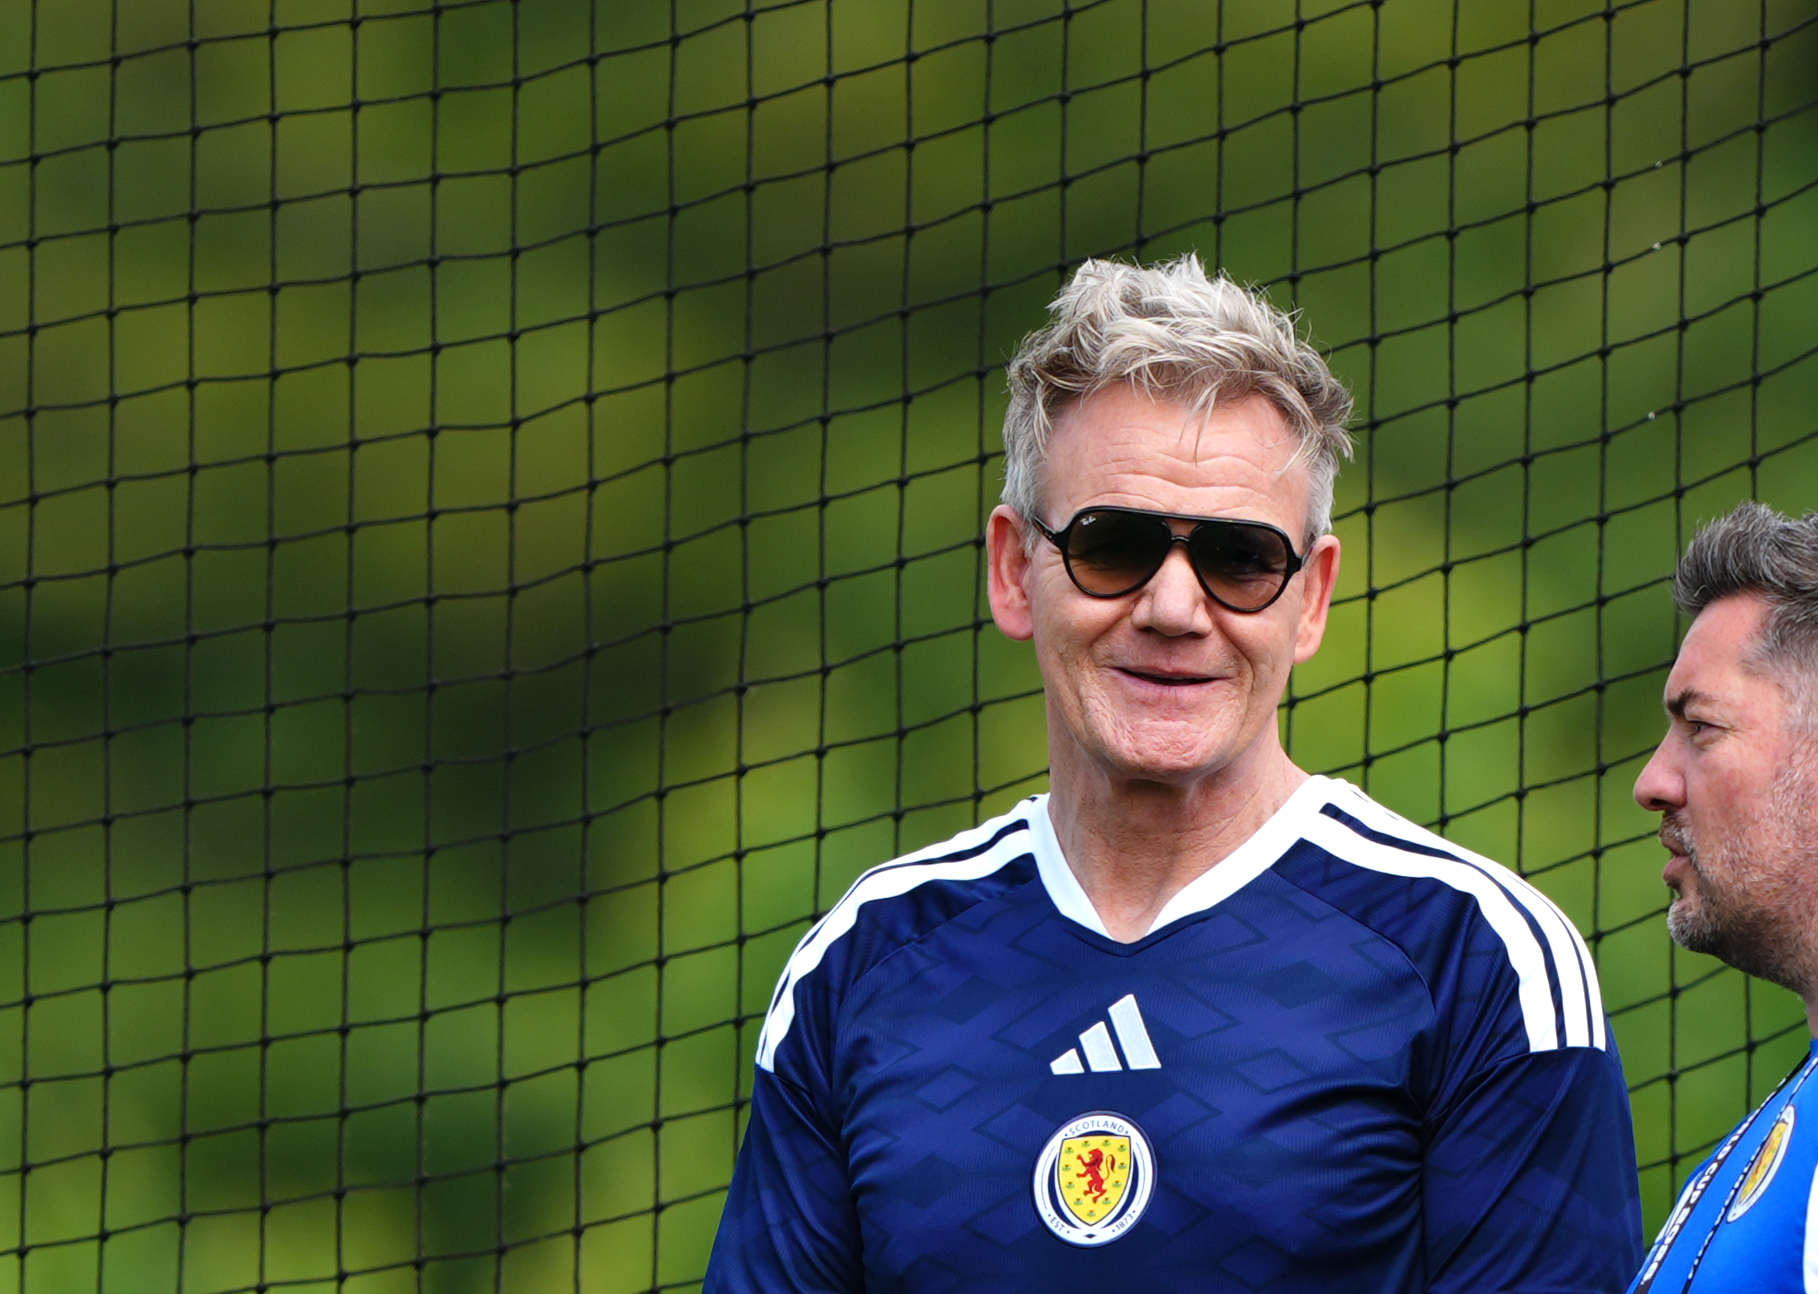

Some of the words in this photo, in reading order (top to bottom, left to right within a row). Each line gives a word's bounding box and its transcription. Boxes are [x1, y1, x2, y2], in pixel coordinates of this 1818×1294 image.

[1069, 1120, 1125, 1135] SCOTLAND
[1689, 1162, 1718, 1204] CUP
[1050, 1217, 1065, 1231] EST
[1115, 1213, 1134, 1231] 1873
